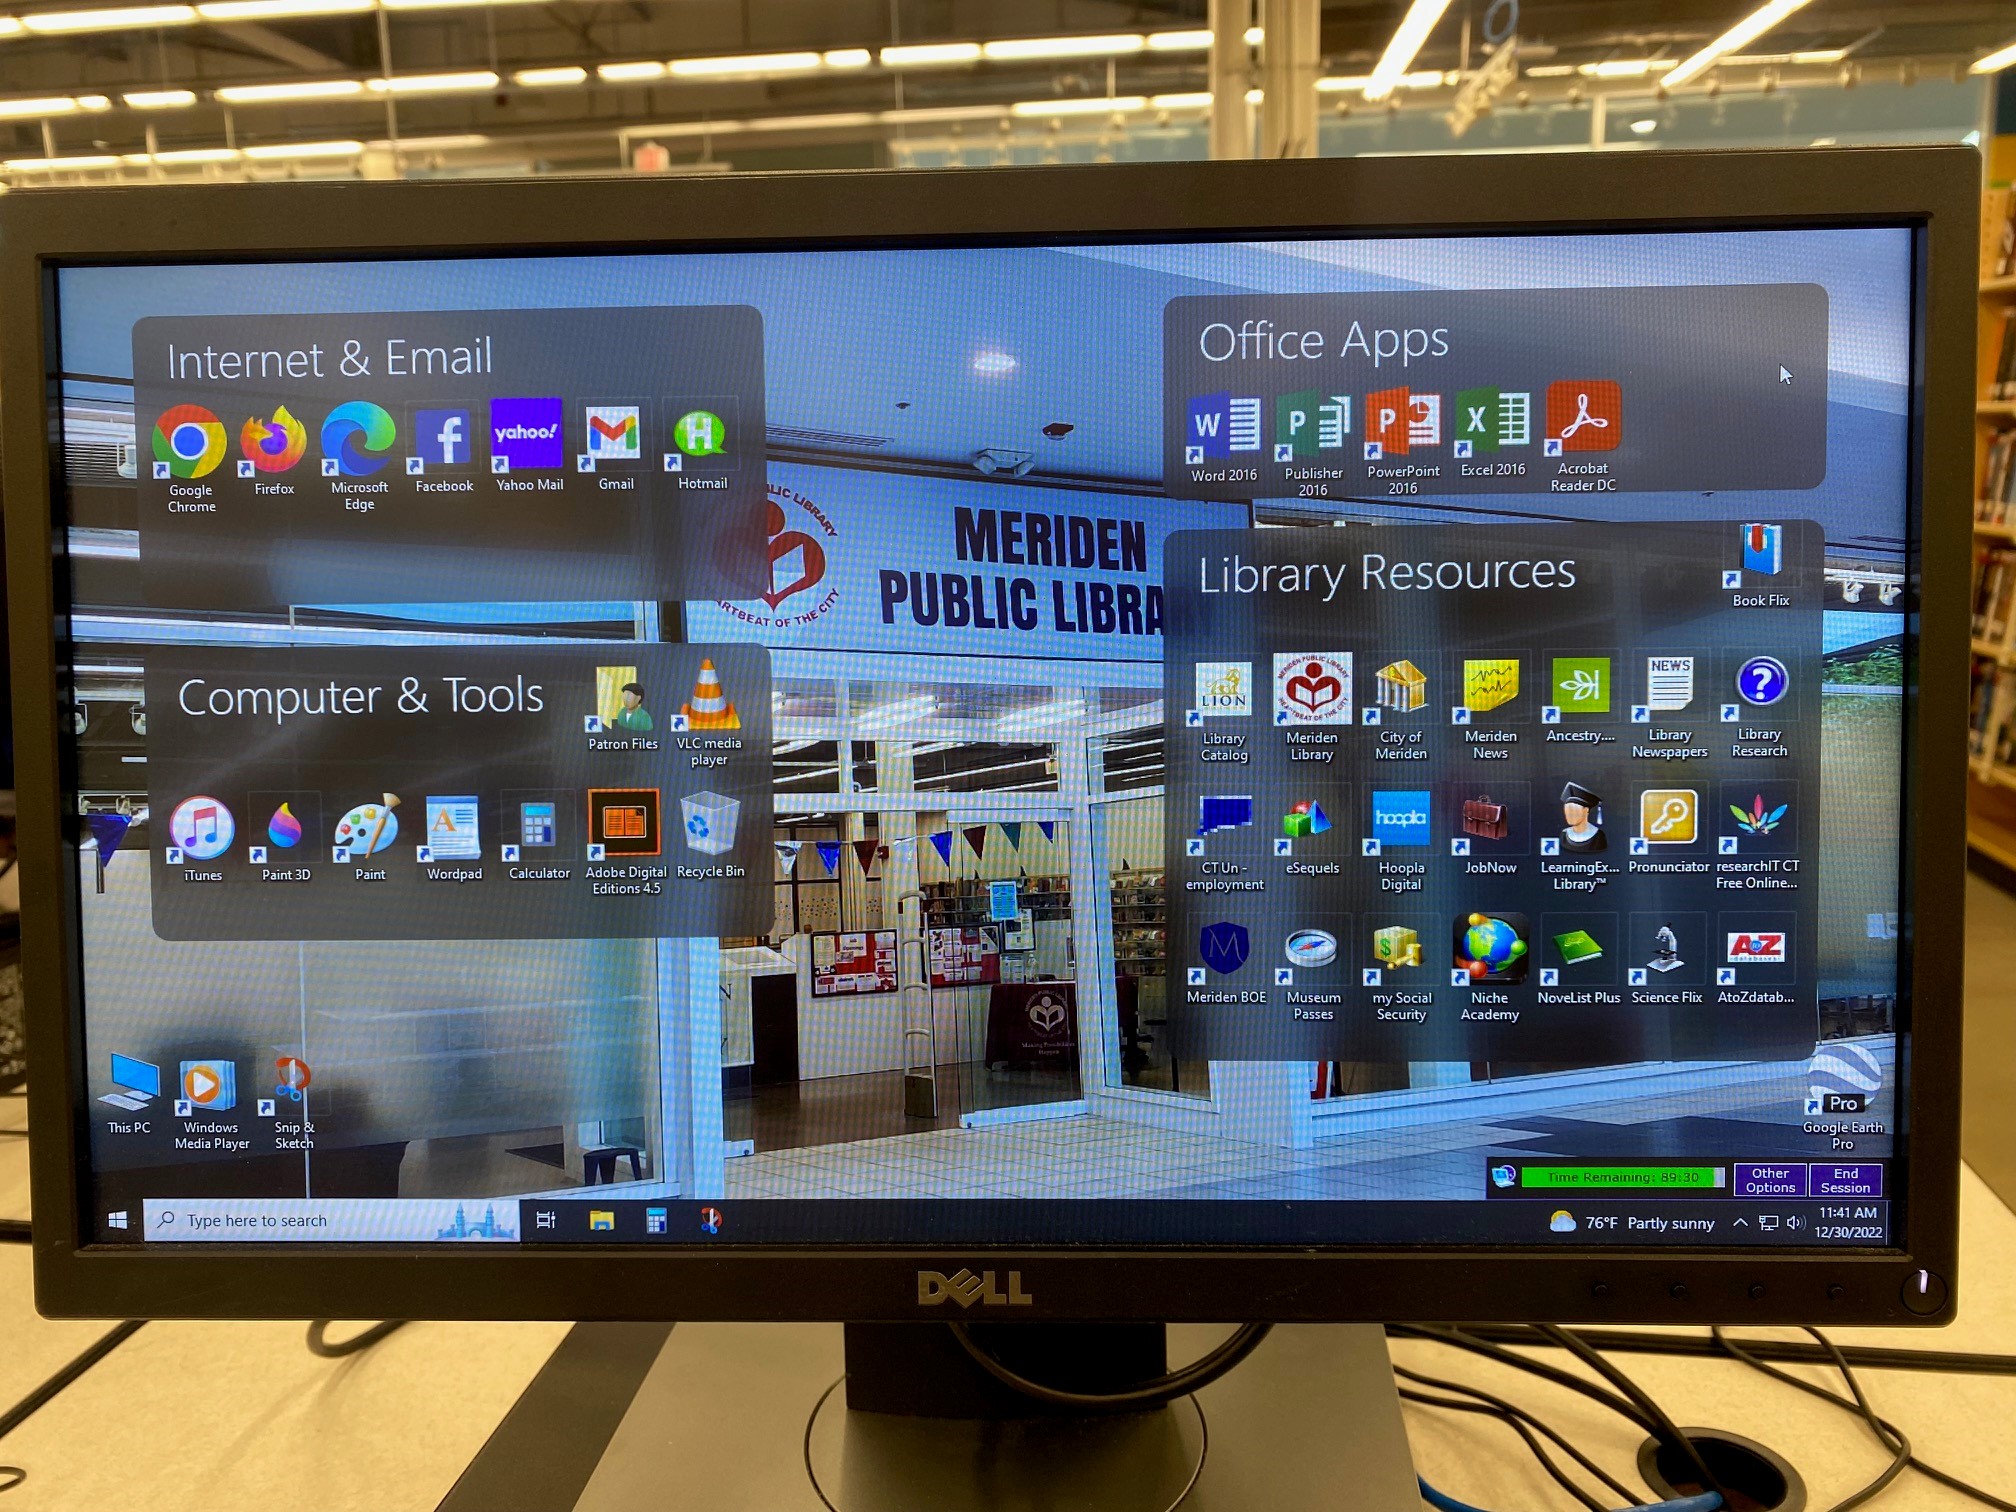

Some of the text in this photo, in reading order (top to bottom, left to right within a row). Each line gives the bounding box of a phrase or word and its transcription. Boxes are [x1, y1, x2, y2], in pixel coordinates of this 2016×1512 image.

[1200, 320, 1449, 368] Office Apps
[167, 336, 493, 379] Internet & Email
[1195, 412, 1221, 437] W
[1290, 410, 1306, 435] P
[1380, 408, 1396, 433] P
[1467, 406, 1487, 432] X
[494, 424, 558, 443] yahoo!
[1191, 467, 1258, 482] Word 2016
[1285, 466, 1343, 483] Publisher
[1367, 465, 1440, 478] PowerPoint
[1461, 463, 1526, 477] Excel 2016
[1557, 462, 1609, 475] Acrobat
[255, 482, 295, 495] Firefox
[331, 481, 389, 493] Microsoft
[416, 479, 474, 492] Facebook
[496, 478, 564, 491] Yahoo Mail
[599, 478, 634, 490] Gmail
[678, 477, 728, 489] Hotmail
[1299, 483, 1328, 496] 2016
[1388, 482, 1418, 495] 2016
[1551, 478, 1616, 492] Reader DC
[169, 484, 213, 499] Google
[168, 500, 216, 513] Chrome
[345, 498, 375, 512] Edge
[793, 493, 838, 537] LIBRARY
[953, 506, 1147, 573] MERIDEN
[1201, 554, 1577, 602] Library Resources
[879, 569, 1038, 631] PUBLIC
[1733, 594, 1790, 606] Book Flix
[775, 618, 791, 627] OF
[794, 610, 819, 625] THE
[818, 588, 840, 613] CITY
[1651, 660, 1691, 671] NEWS
[179, 674, 545, 725] Computer & Tools
[1202, 695, 1246, 706] LION
[1203, 733, 1245, 747] Library
[1286, 732, 1338, 744] Meriden
[1380, 731, 1423, 745] City of
[1465, 730, 1517, 742] Meriden
[1649, 729, 1692, 743] Library
[1738, 728, 1782, 743] Library
[588, 737, 659, 750] Patron Files
[676, 737, 742, 749] VLC media
[1201, 750, 1249, 763] Catalog
[1291, 749, 1334, 762] Library
[1375, 748, 1427, 760] Meriden
[1473, 747, 1508, 759] News
[1632, 745, 1708, 760] Newspapers
[1732, 744, 1788, 757] Research
[691, 754, 728, 767] player
[1375, 810, 1426, 828] hoopla
[677, 865, 745, 880] Recycle Bin
[1202, 862, 1220, 874] CT
[1221, 862, 1240, 874] Un
[1286, 861, 1340, 878] eSequels
[1380, 861, 1425, 877] Hoopla
[1465, 863, 1517, 874] JobNow
[1541, 861, 1620, 875] LearningEx...
[1629, 861, 1711, 873] Pronunciator
[1716, 860, 1800, 872] researchIT CT
[184, 869, 223, 881] iTunes
[262, 869, 312, 881] Paint 3D
[355, 869, 386, 880] Paint
[427, 868, 483, 883] Wordpad
[509, 867, 571, 880] Calculator
[586, 865, 667, 882] Adobe Digital
[593, 882, 661, 895] Editions 4.5
[1186, 878, 1264, 892] employment
[1381, 878, 1421, 892] Digital
[1716, 876, 1798, 889] Free Online...
[1187, 991, 1267, 1003] Meriden BOE
[1287, 991, 1341, 1004] Museum
[1373, 991, 1432, 1007] my Social
[1471, 992, 1509, 1004] Niche
[1538, 991, 1621, 1004] NoveList Plus
[1632, 991, 1703, 1003] Science Flix
[1718, 991, 1795, 1003] AtoZdatab...
[1294, 1008, 1334, 1020] Passes
[1377, 1008, 1427, 1023] Security
[1460, 1008, 1519, 1023] Academy
[1830, 1096, 1858, 1110] Pro
[107, 1122, 151, 1133] This PC
[184, 1122, 239, 1133] Windows
[275, 1122, 315, 1135] Snip &
[1803, 1121, 1883, 1135] Google Earth
[175, 1138, 250, 1151] Media Player
[275, 1138, 314, 1149] Sketch
[1832, 1138, 1854, 1149] Pro
[1548, 1172, 1699, 1184] Time Remaining: 89:30
[1752, 1168, 1790, 1179] Other
[1834, 1168, 1859, 1179] End
[1746, 1182, 1796, 1195] Options
[1821, 1182, 1871, 1193] Session
[1819, 1207, 1878, 1218] 11:41 AM
[187, 1213, 327, 1229] Type here to search
[1586, 1216, 1715, 1232] 76°F Partly sunny
[1814, 1226, 1883, 1239] 12/30/2022
[917, 1268, 1033, 1309] DELL
